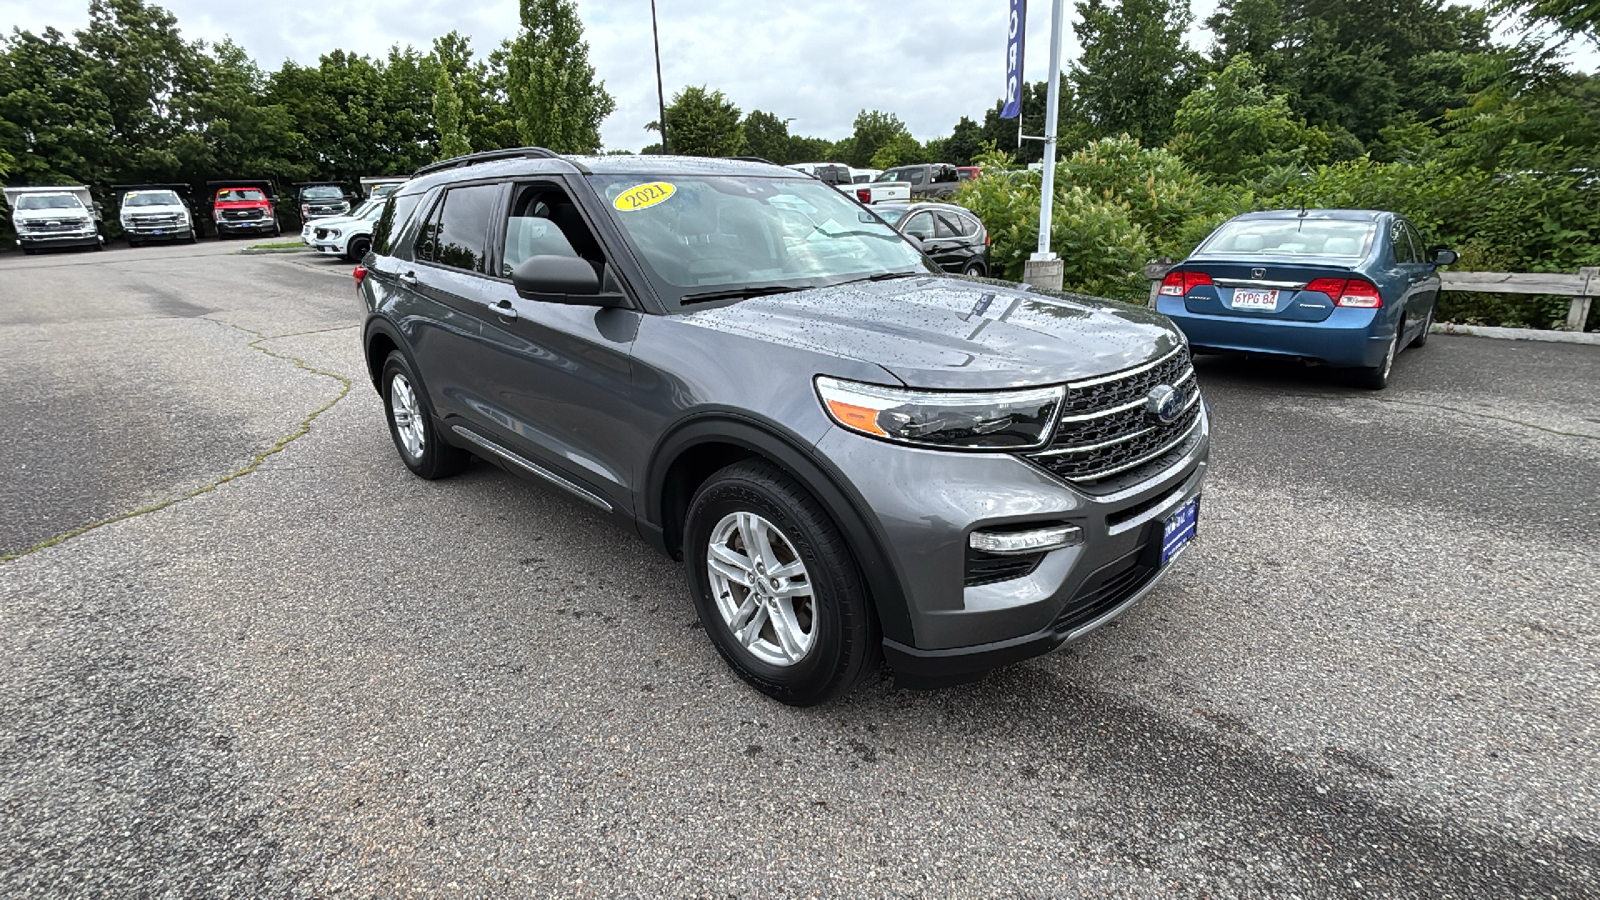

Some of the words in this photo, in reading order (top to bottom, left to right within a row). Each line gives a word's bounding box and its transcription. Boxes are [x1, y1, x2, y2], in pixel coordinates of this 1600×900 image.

[625, 185, 668, 208] 2021
[1235, 292, 1260, 304] 6YPG
[1262, 294, 1275, 305] 84
